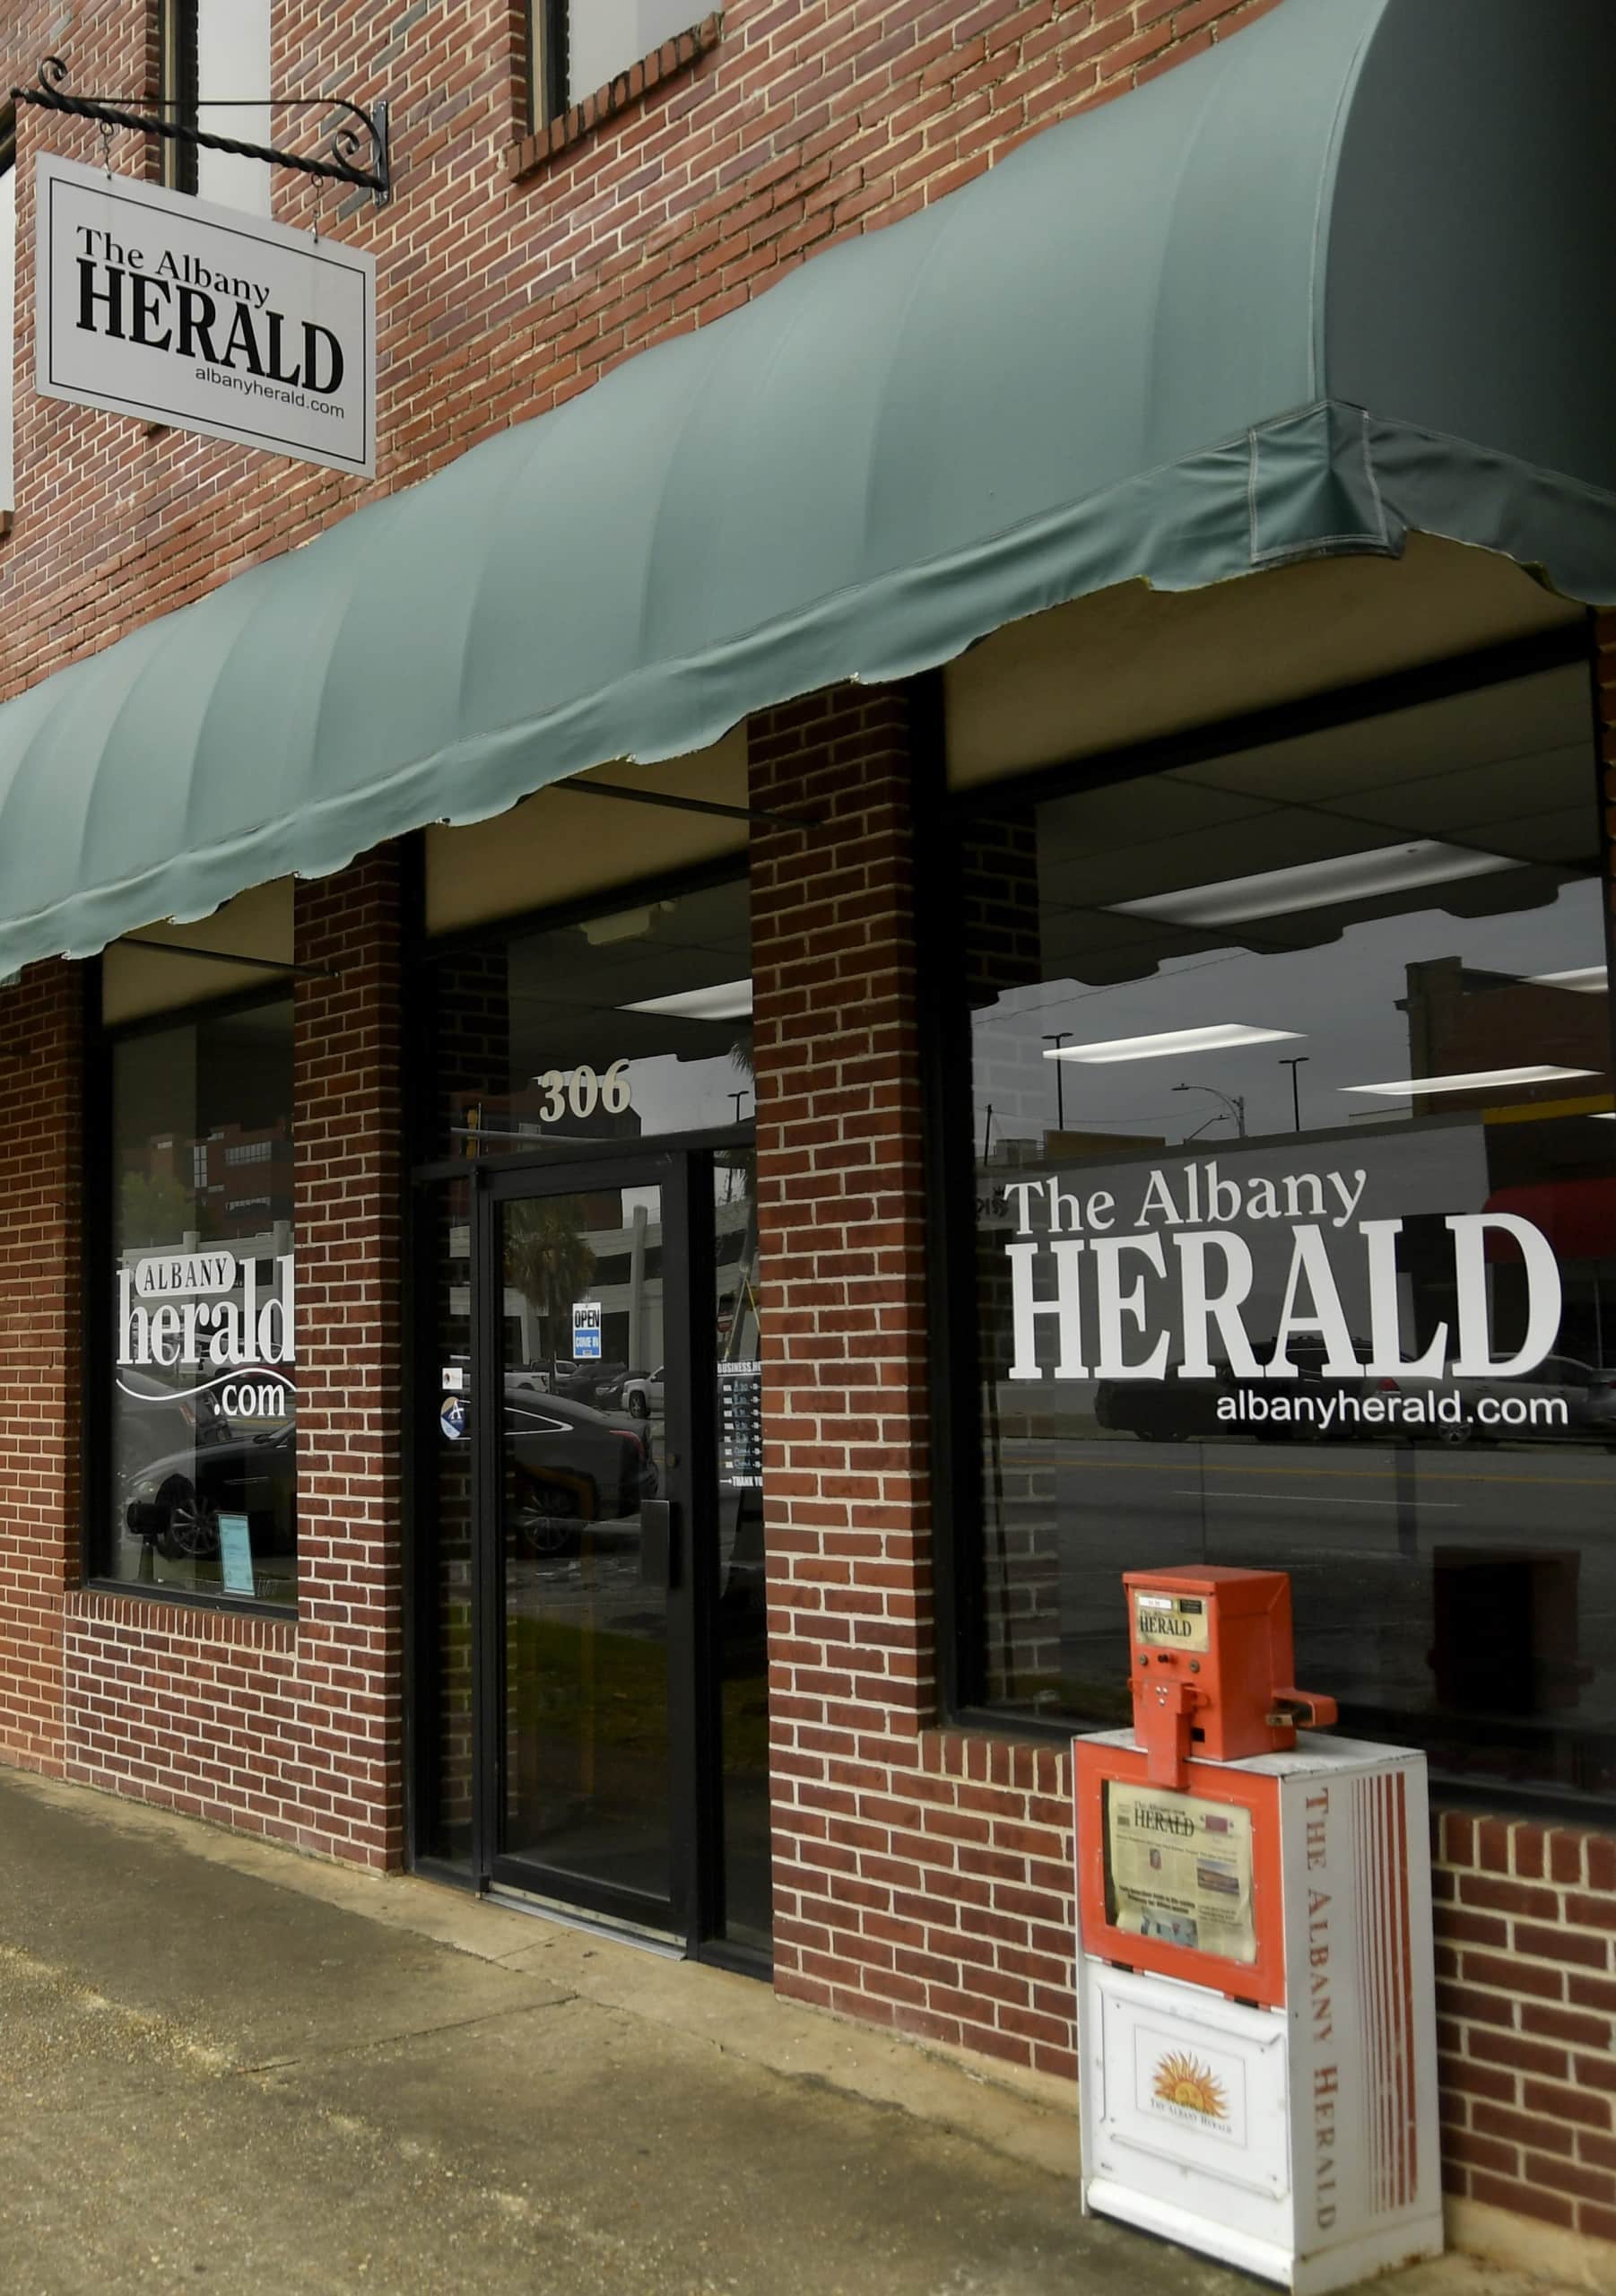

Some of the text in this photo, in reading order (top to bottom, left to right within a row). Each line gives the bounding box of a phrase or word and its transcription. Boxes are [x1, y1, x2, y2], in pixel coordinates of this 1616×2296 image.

[76, 225, 270, 309] The Albany
[76, 257, 344, 394] HERALD
[195, 367, 345, 419] albanyherald.com
[540, 1058, 630, 1122] 306
[1002, 1161, 1368, 1236] The Albany
[143, 1257, 228, 1292] ALBANY
[1004, 1212, 1562, 1381] HERALD
[116, 1254, 296, 1366] herald
[575, 1309, 600, 1328] OPEN
[717, 1361, 752, 1374] BUSINESS
[213, 1384, 286, 1416] .com
[1216, 1389, 1568, 1430] albanyherald.com
[731, 1475, 754, 1487] THANK
[1139, 1614, 1193, 1638] HERALD
[1134, 1806, 1195, 1838] HERALD
[1306, 1787, 1339, 2231] THE ALBANY HERALD
